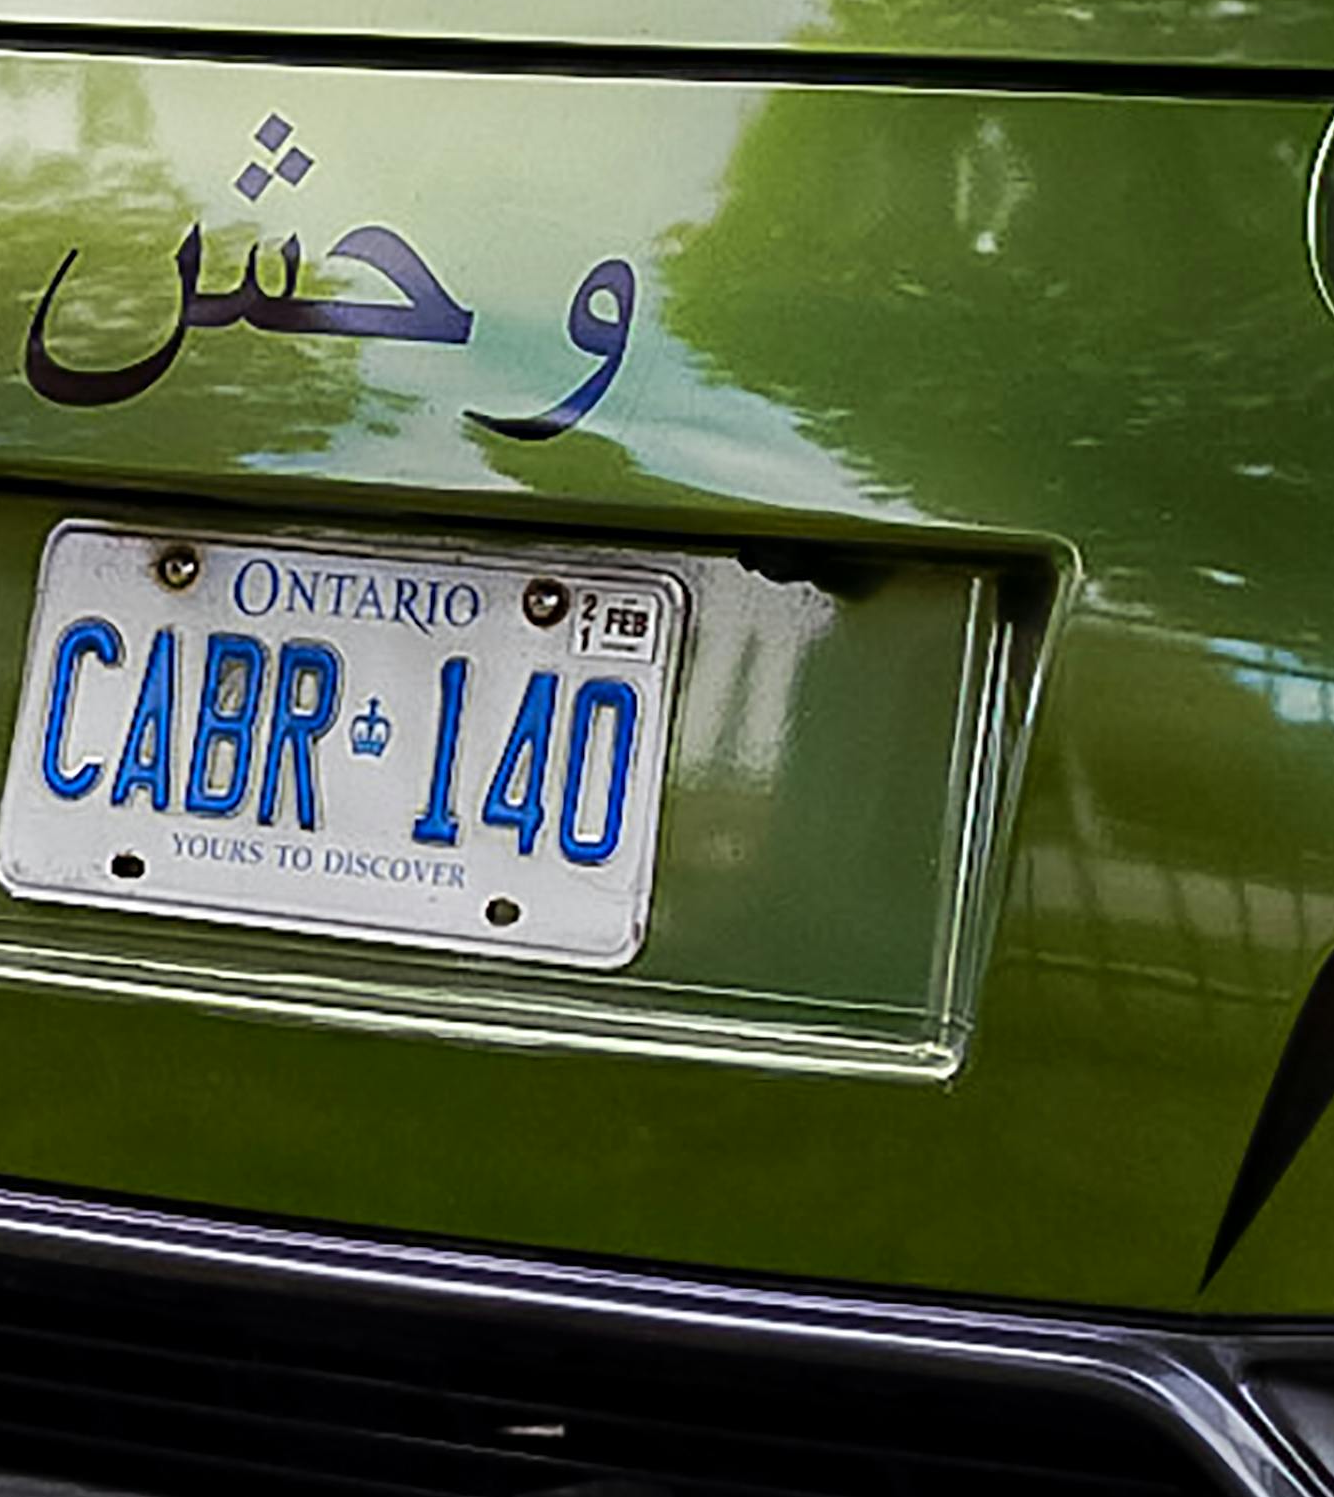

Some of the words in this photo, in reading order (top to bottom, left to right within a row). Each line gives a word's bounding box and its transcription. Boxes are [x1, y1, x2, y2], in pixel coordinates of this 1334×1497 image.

[25, 113, 636, 440] وحش
[233, 558, 481, 637] ONTARIO
[604, 607, 649, 638] FEB
[41, 618, 343, 833] CABR
[412, 656, 641, 866] 140
[171, 831, 265, 865] YOURS
[274, 843, 313, 872] TO
[323, 848, 466, 889] DISCOVER
